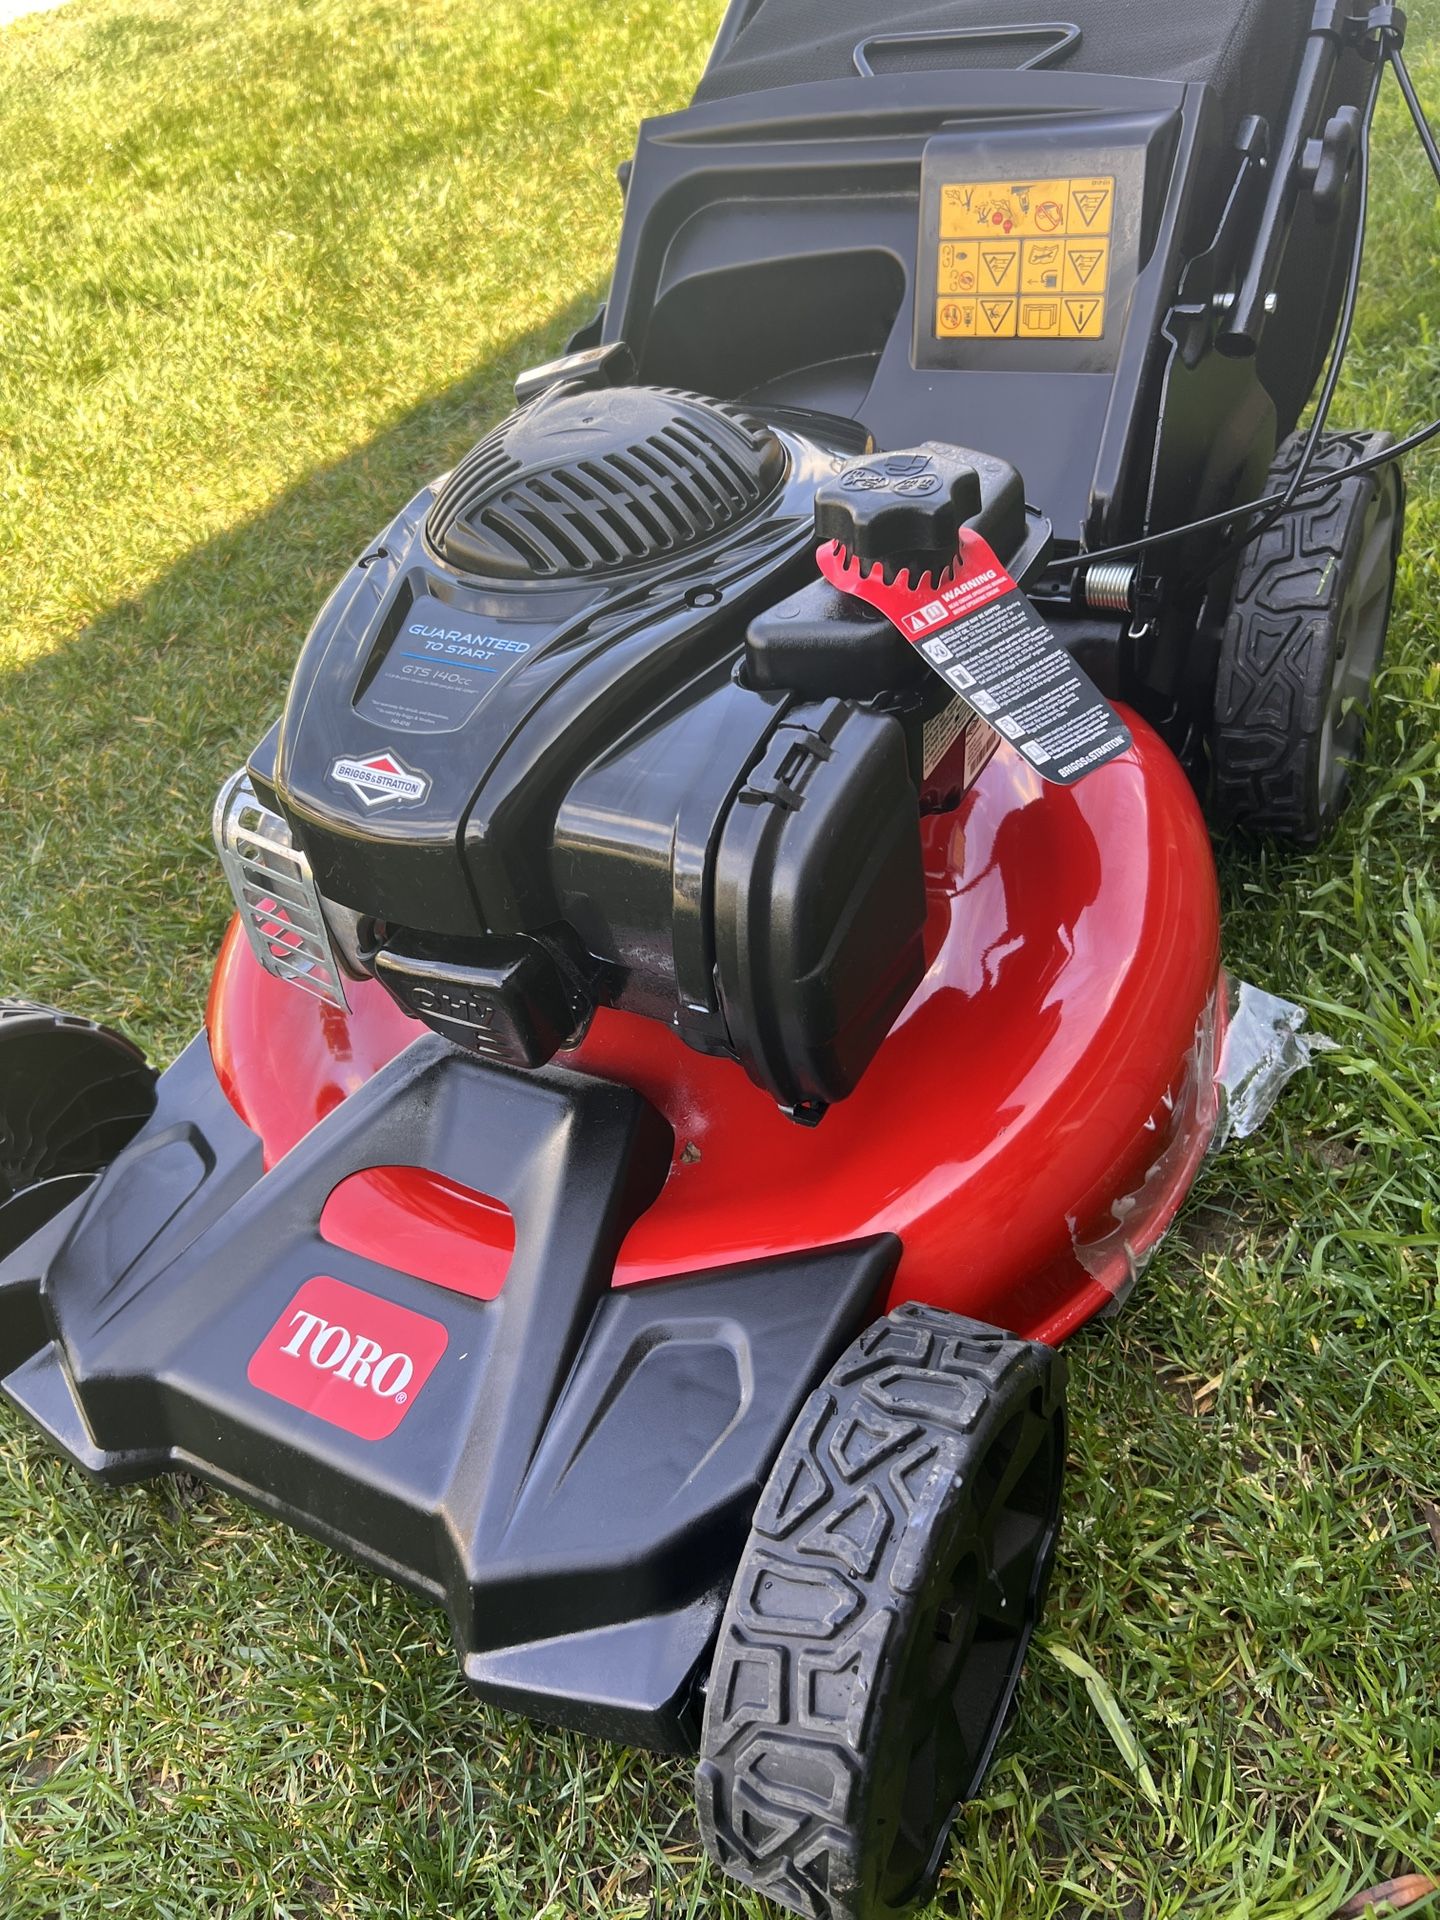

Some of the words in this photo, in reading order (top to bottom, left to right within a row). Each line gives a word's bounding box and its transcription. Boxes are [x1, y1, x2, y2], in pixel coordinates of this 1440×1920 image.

[941, 569, 997, 602] WARNING
[408, 624, 531, 653] GUARANTEED
[424, 640, 444, 651] TO
[447, 644, 496, 661] START
[402, 665, 432, 677] GTS
[433, 671, 473, 686] 140cc
[338, 766, 419, 793] BRIGGS&STRATTON
